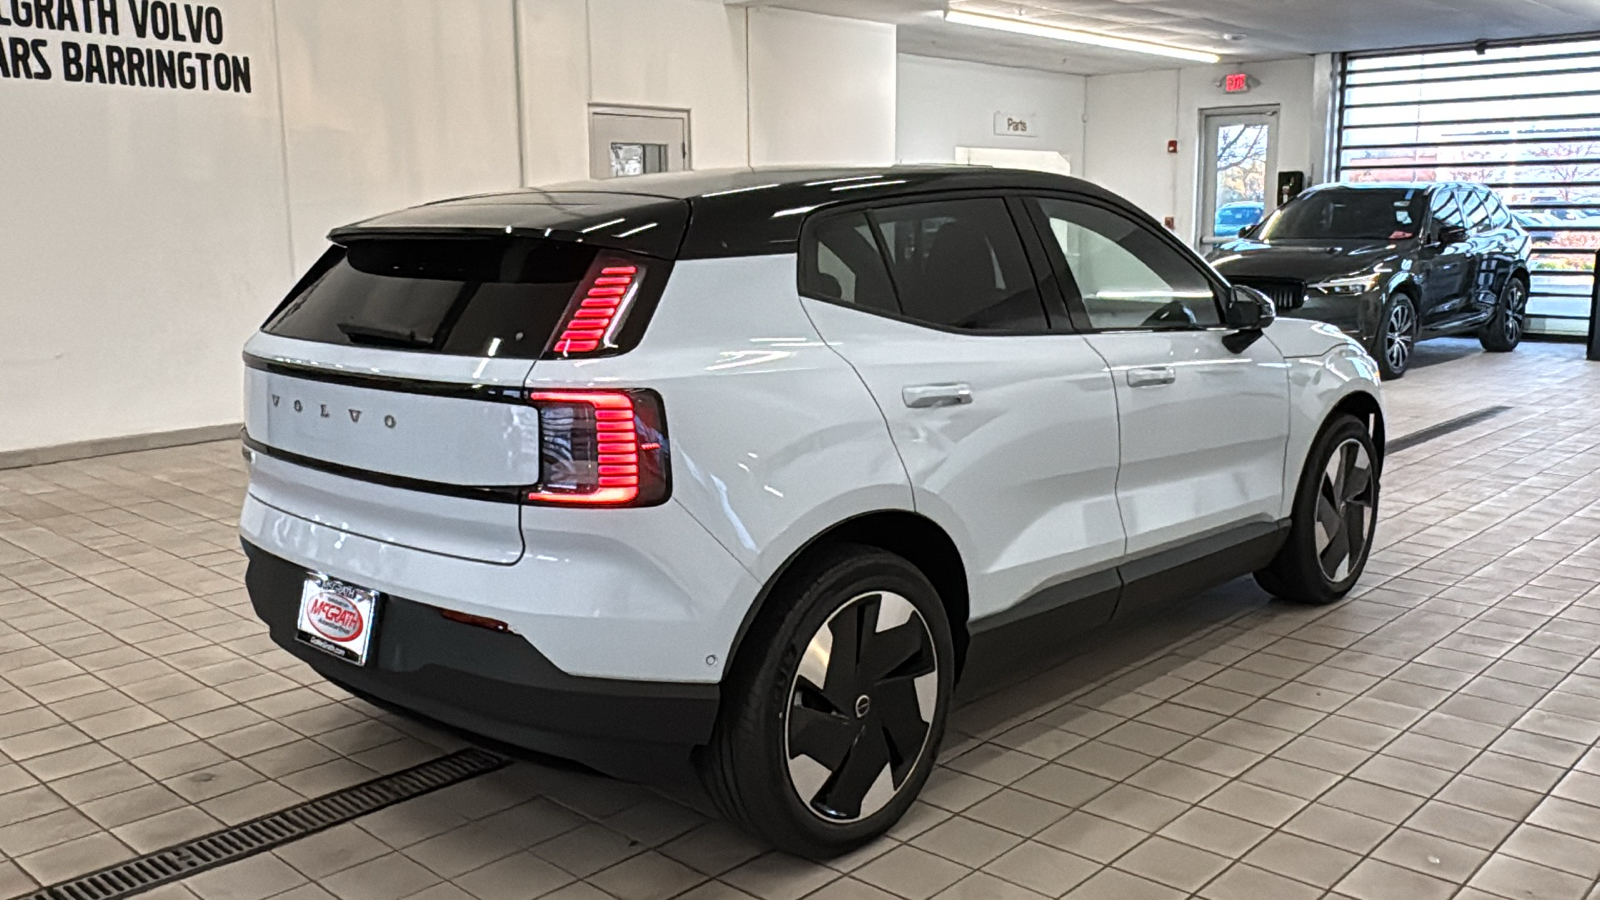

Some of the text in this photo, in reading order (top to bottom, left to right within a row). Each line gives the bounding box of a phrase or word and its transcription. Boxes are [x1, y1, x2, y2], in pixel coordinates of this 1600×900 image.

[0, 0, 223, 45] GRATH VOLVO
[61, 41, 252, 93] BARRINGTON
[1226, 74, 1247, 92] EXIT
[1007, 117, 1027, 131] Parts
[271, 394, 397, 428] VOLVO
